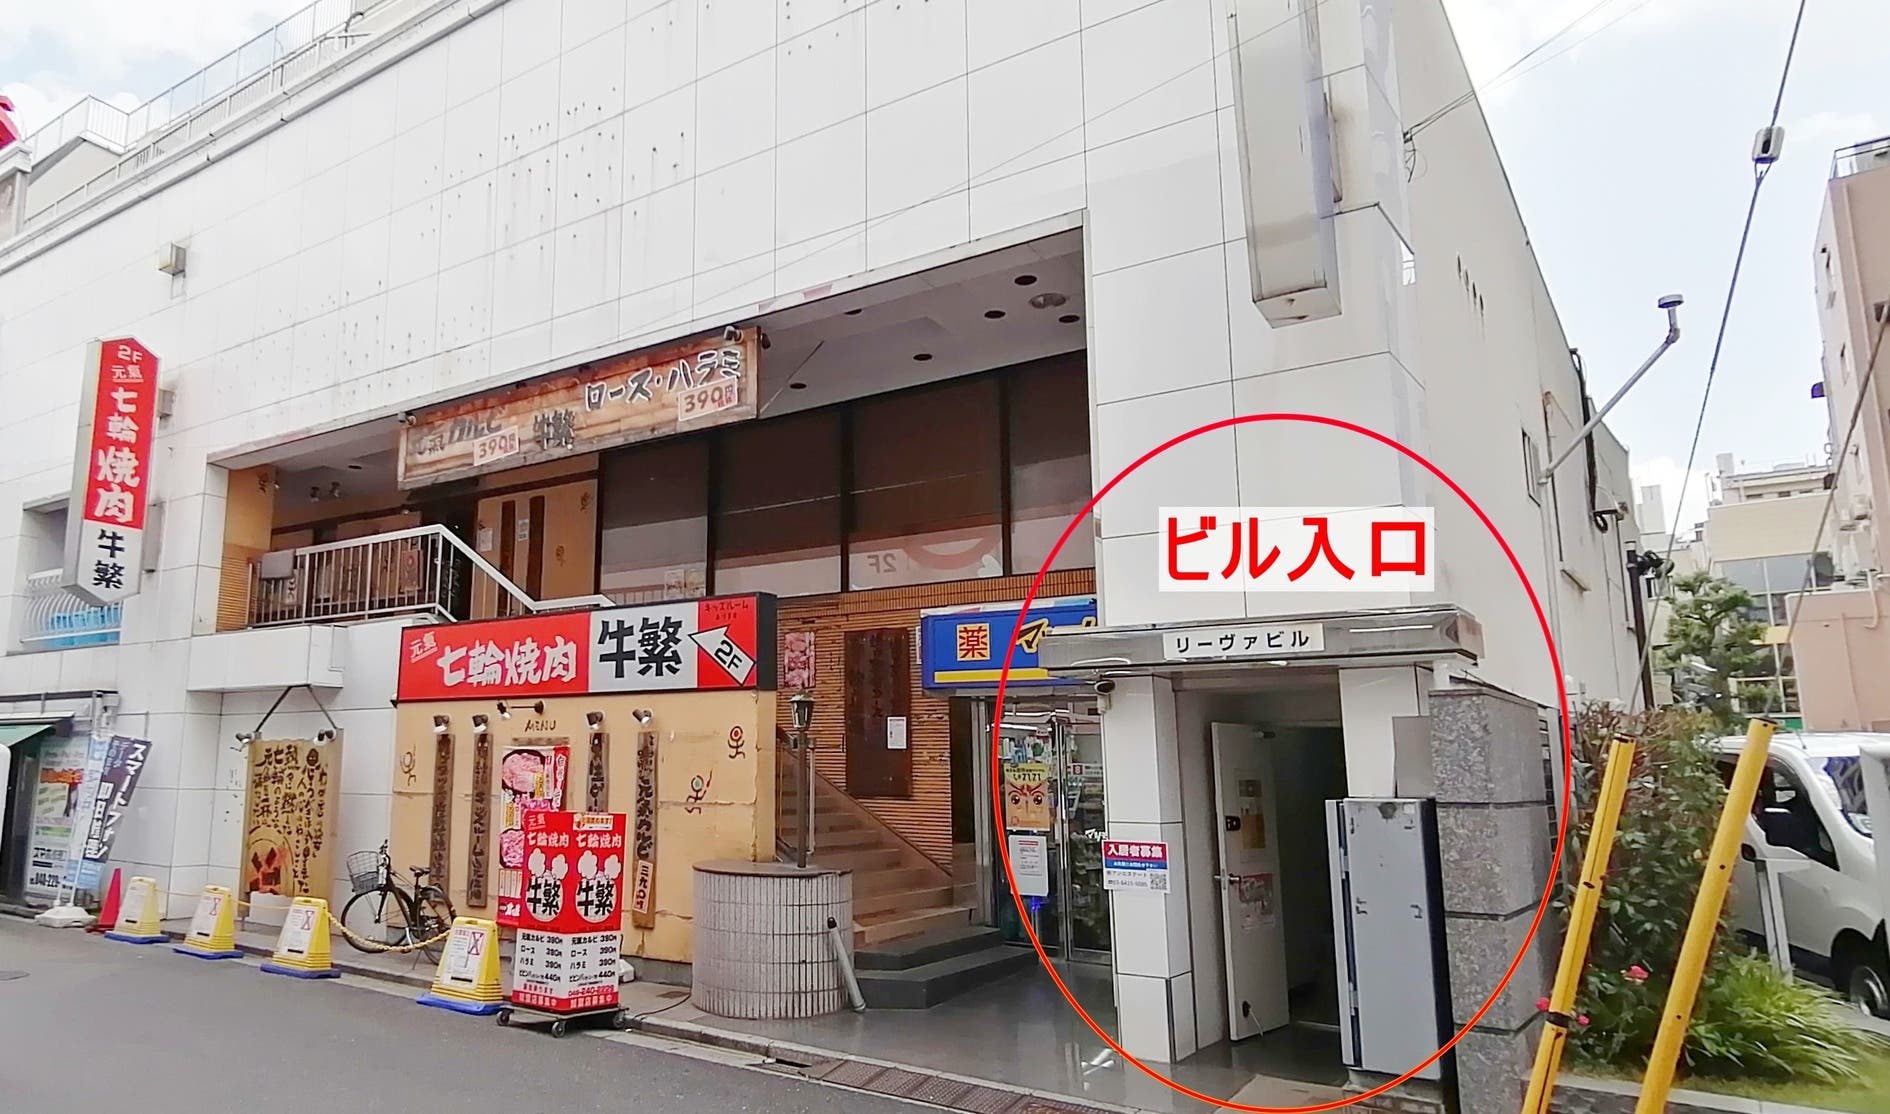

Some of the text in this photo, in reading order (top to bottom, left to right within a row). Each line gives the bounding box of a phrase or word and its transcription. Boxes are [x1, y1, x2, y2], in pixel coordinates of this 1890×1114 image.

[118, 345, 143, 362] 2F
[94, 387, 141, 523] 七輪焼肉
[92, 529, 125, 590] 牛繁
[597, 616, 683, 678] 牛繁
[958, 626, 989, 658] 薬
[1175, 630, 1310, 654] リーヴァビル
[437, 635, 577, 688] 七輪焼肉
[714, 640, 742, 669] 2F
[525, 719, 556, 732] MENU
[103, 743, 147, 860] スマートフォン
[527, 831, 570, 849] 七輪焼肉
[576, 832, 622, 849] 七輪焼肉
[1107, 843, 1163, 858] 入居者募集
[526, 876, 560, 916] 牛繁
[576, 879, 615, 917] 牛繁
[519, 957, 534, 966] ハラミ
[520, 945, 535, 954] ロース
[570, 949, 588, 957] ロース
[569, 961, 586, 970] ハラミ
